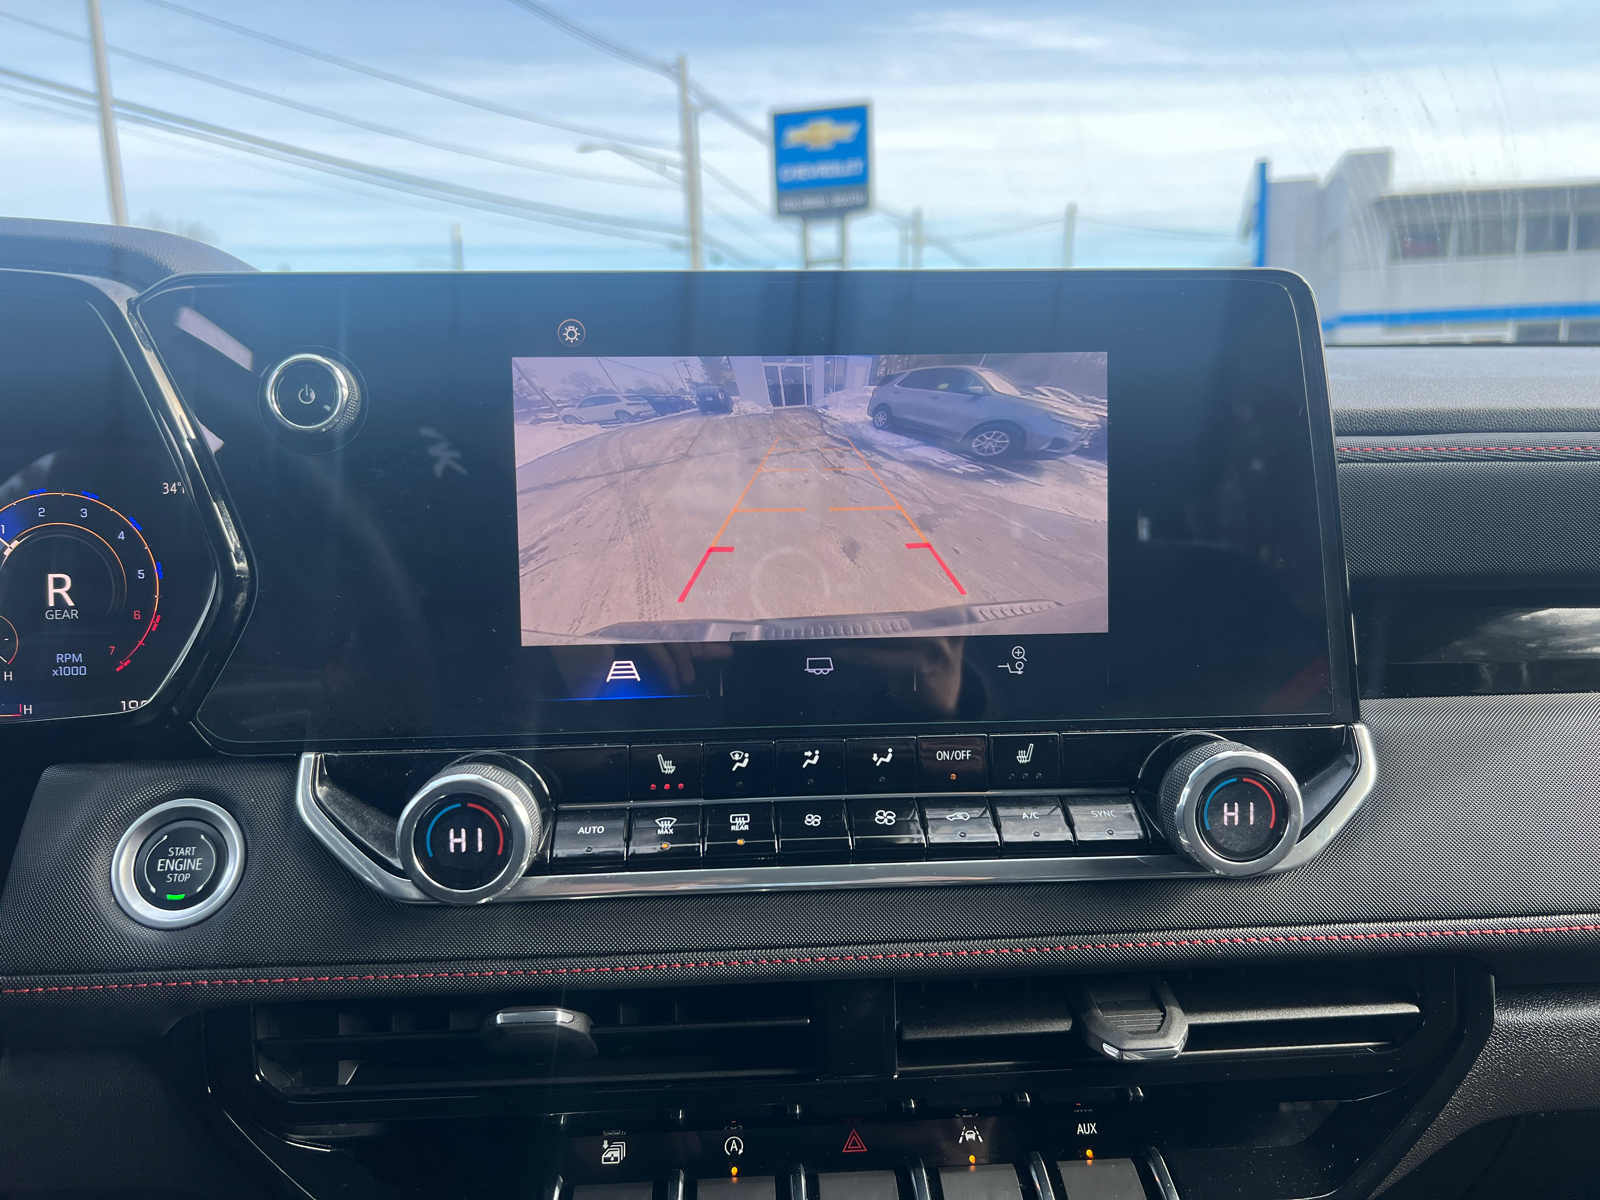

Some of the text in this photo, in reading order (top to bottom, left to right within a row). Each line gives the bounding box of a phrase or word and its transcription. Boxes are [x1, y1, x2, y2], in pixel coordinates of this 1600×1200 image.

[38, 508, 46, 517] 2
[80, 508, 88, 518] 3
[117, 531, 126, 541] 4
[137, 570, 145, 579] 5
[47, 573, 75, 607] R
[45, 609, 79, 620] GEAR
[133, 610, 141, 620] 6
[109, 646, 116, 655] 7
[56, 653, 83, 663] RPM
[4, 671, 13, 681] H
[52, 665, 87, 677] x1000
[23, 705, 33, 715] H
[936, 750, 972, 761] ON/OFF
[1022, 811, 1040, 820] A/C
[1090, 809, 1117, 818] SYNC
[577, 825, 605, 835] AUTO
[657, 827, 674, 835] MAX
[731, 823, 749, 831] REAR
[168, 846, 197, 857] START
[157, 857, 203, 872] ENGINE
[166, 873, 191, 883] STOP
[1076, 1122, 1098, 1135] AUX
